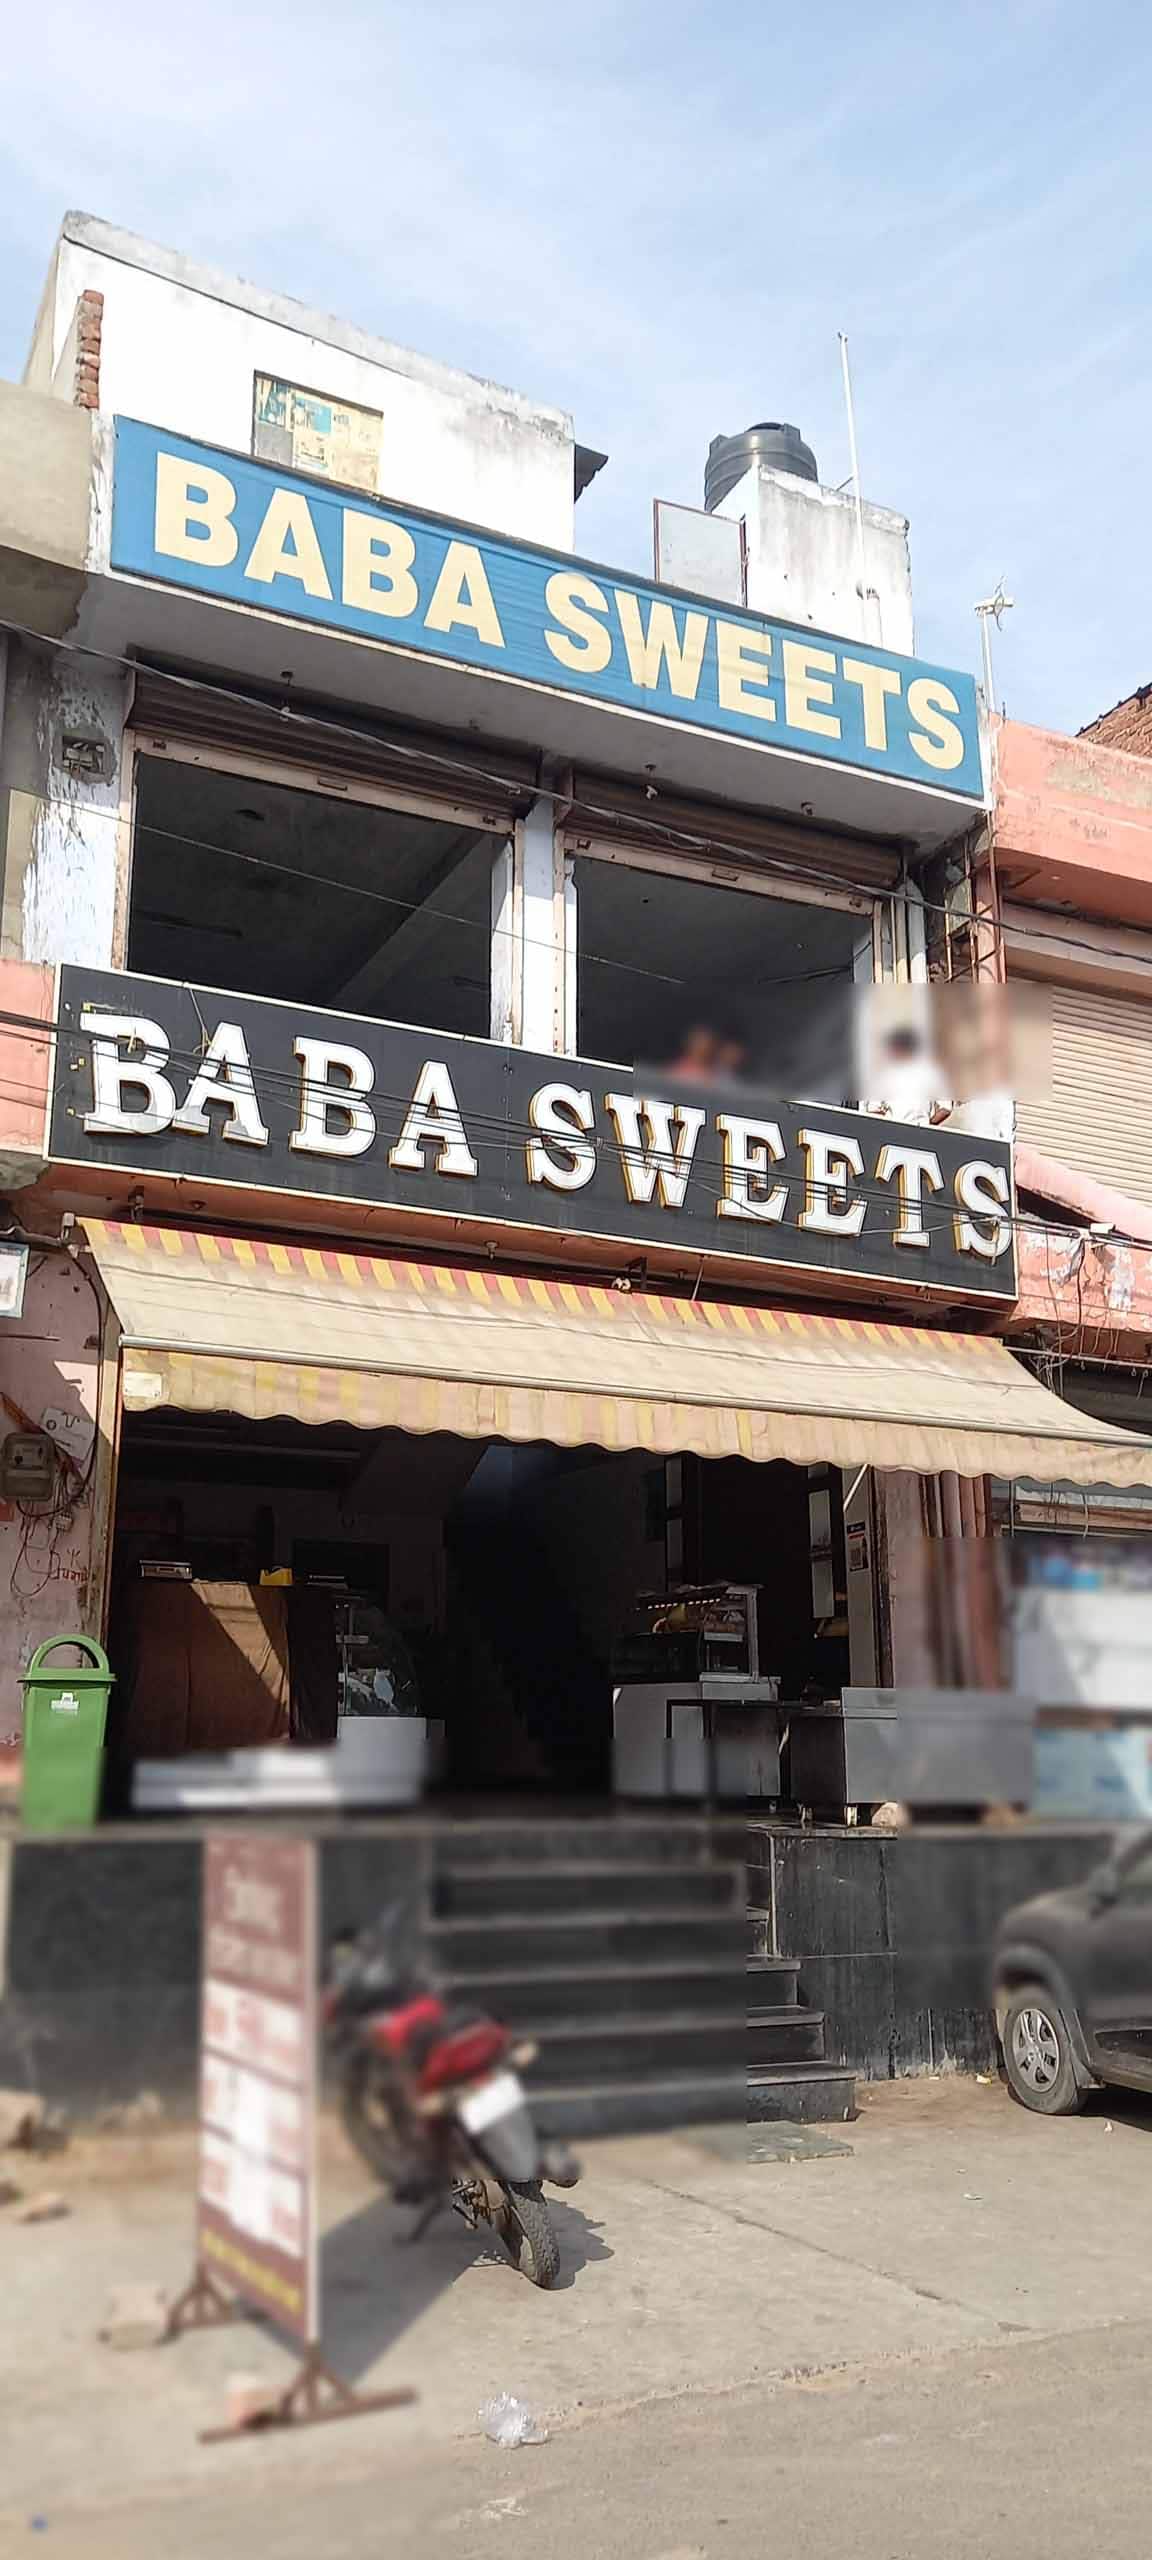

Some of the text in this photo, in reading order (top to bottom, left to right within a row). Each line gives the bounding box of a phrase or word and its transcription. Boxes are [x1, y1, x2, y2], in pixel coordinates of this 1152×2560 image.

[154, 452, 965, 771] BABA SWEETS
[81, 1013, 1013, 1258] BABA SWEETS
